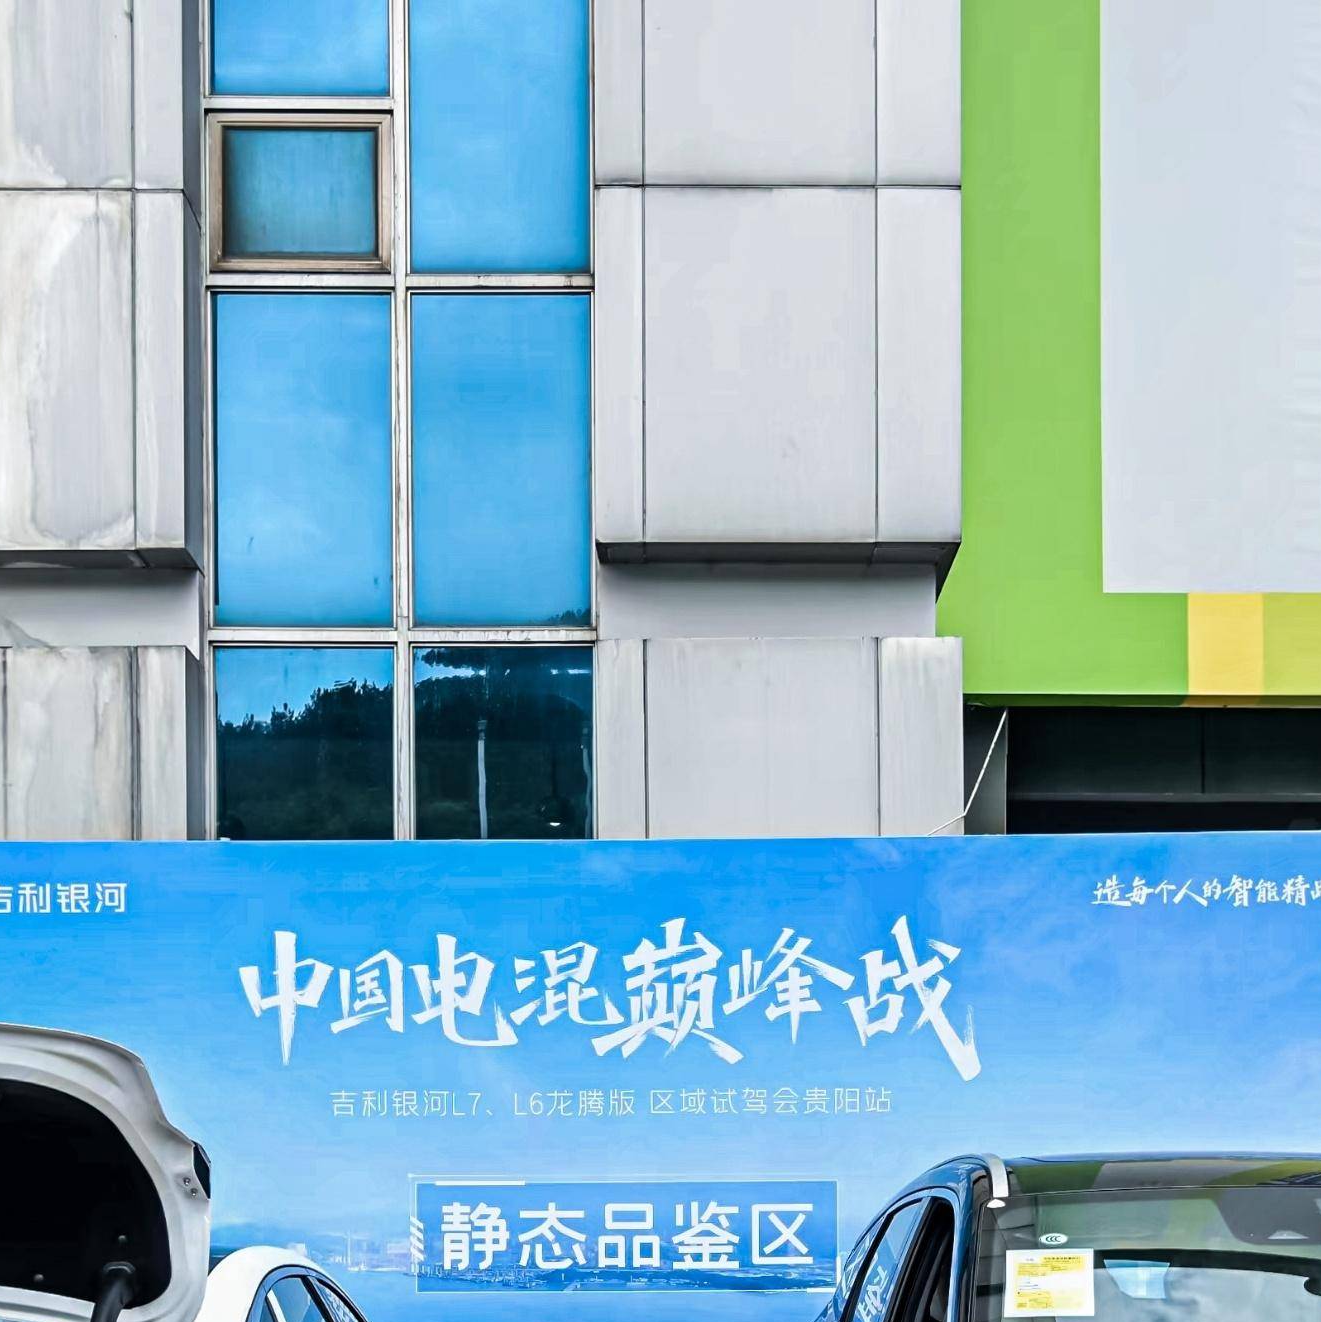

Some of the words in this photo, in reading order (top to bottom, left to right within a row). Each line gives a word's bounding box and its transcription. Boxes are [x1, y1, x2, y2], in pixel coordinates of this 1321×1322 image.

[238, 914, 981, 1082] 中国电混巅峰战
[330, 1088, 636, 1117] 吉利银河L7、L6龙腾版
[650, 1087, 893, 1115] 区域试驾会贵阳站
[440, 1201, 814, 1270] 静态品鉴区
